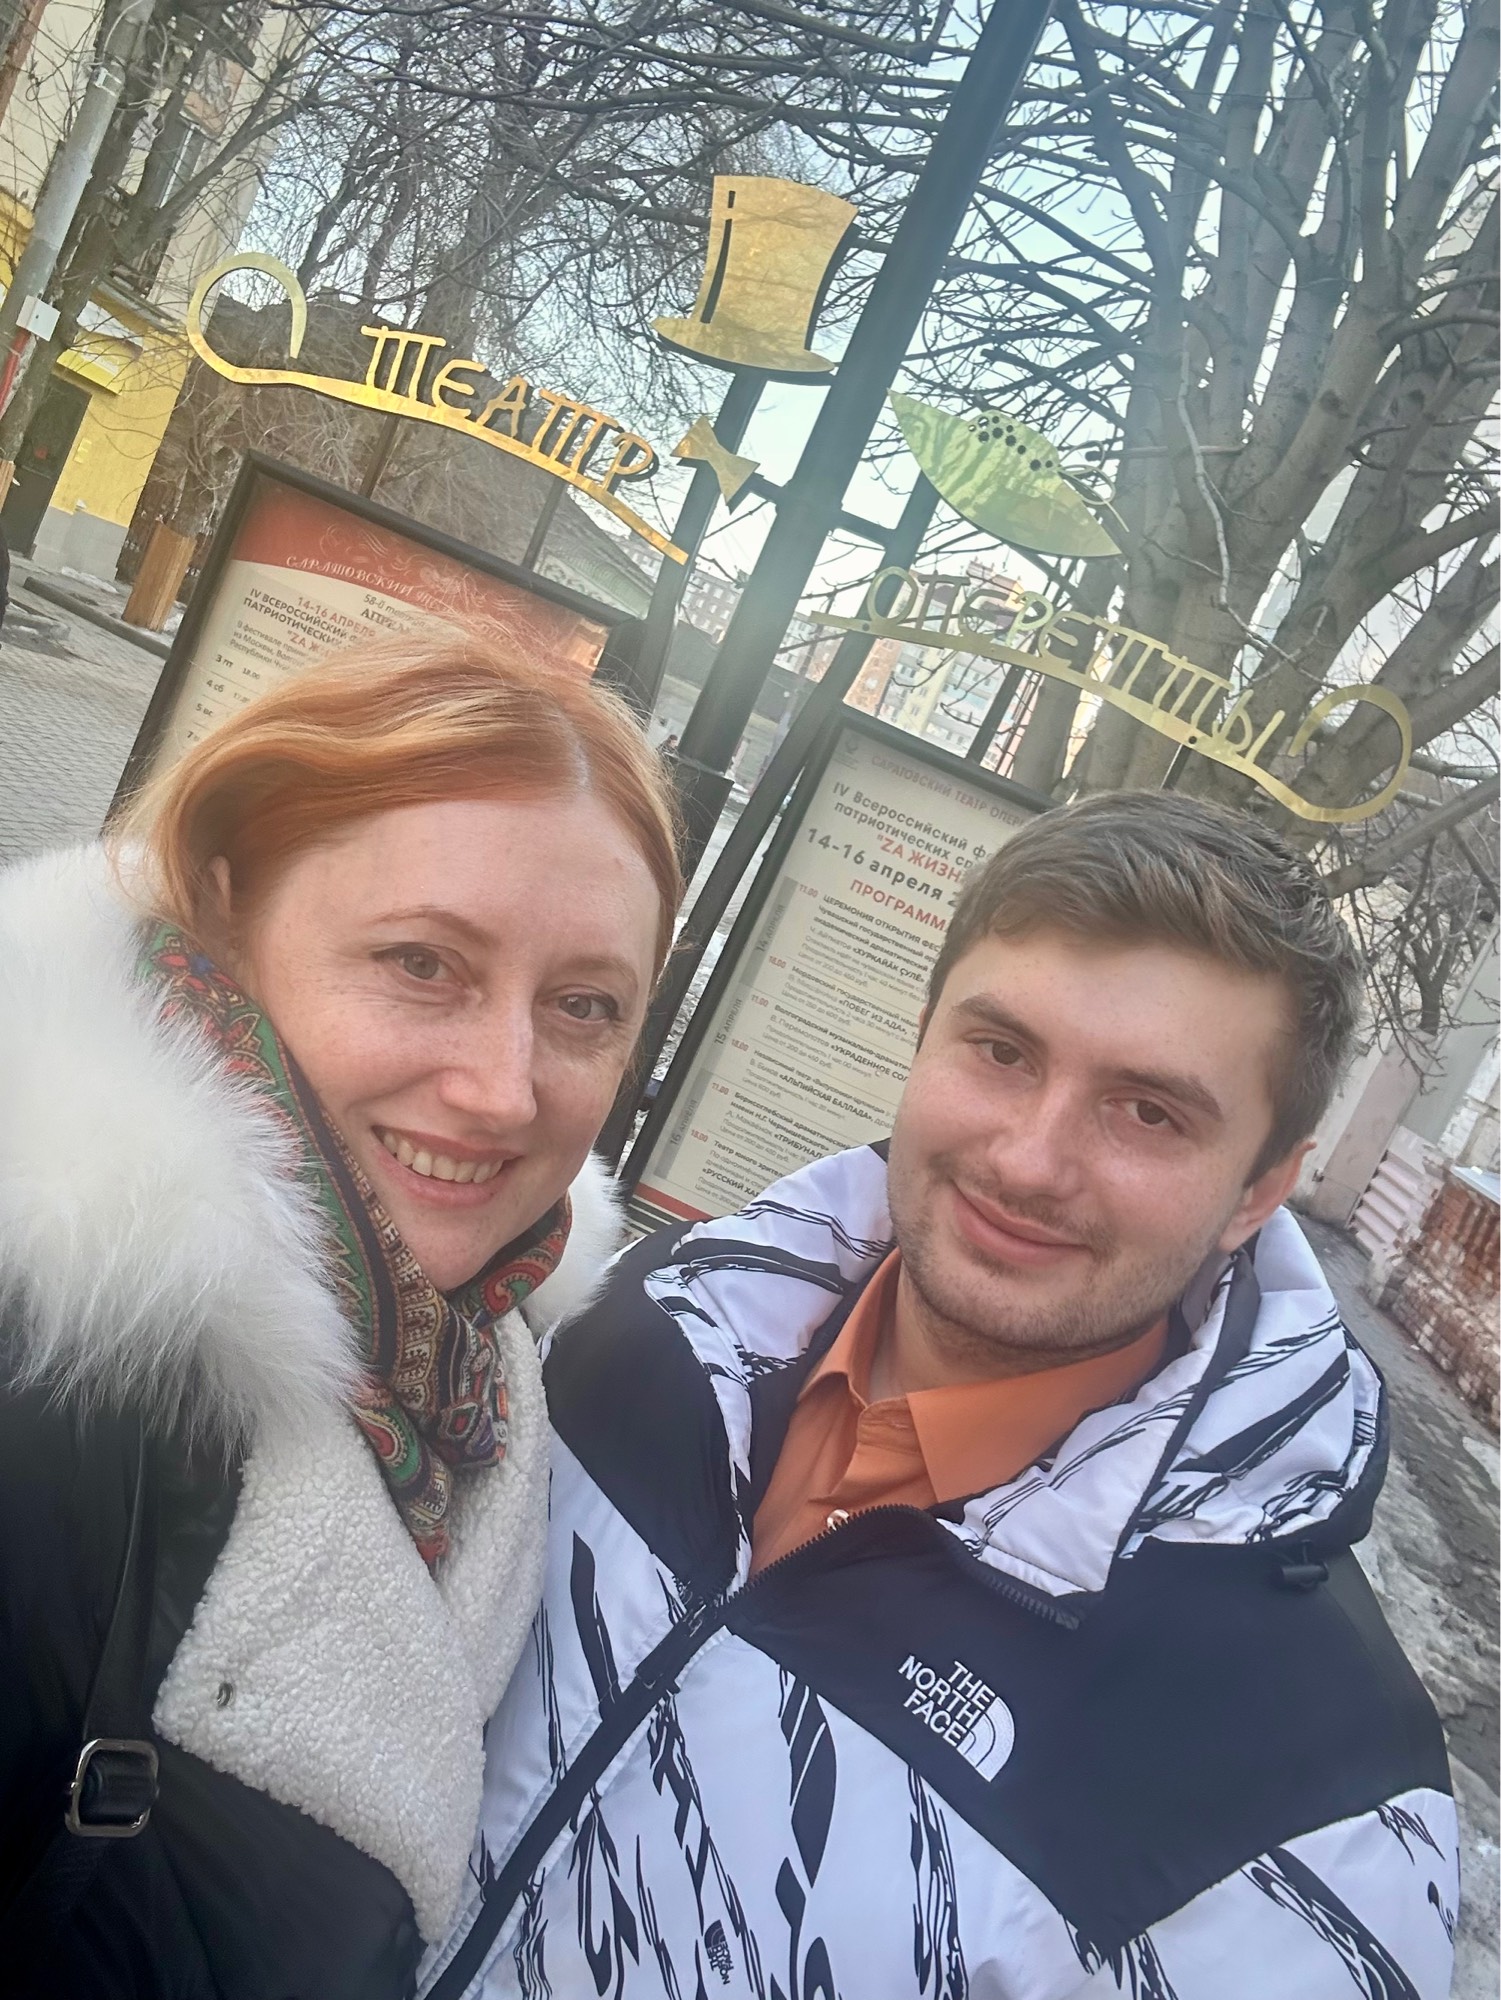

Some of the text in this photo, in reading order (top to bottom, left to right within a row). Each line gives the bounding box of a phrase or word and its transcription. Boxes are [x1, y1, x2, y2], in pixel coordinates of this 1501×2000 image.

[360, 325, 656, 486] ТЕАТР
[287, 556, 412, 596] САРАТОВСКИЙ
[251, 588, 348, 638] IV ВСЕРОССИЙСКИЙ
[298, 597, 328, 616] 14-16
[214, 682, 224, 692] сб
[223, 658, 233, 667] пт
[866, 566, 1286, 759] ОПЕРЕТТЫ
[203, 708, 213, 716] вс
[871, 755, 950, 796] САРАТОВСКИЙ
[955, 790, 987, 812] ТЕАТР
[833, 782, 968, 850] IV Всероссийский
[835, 801, 950, 859] патриотических
[805, 828, 866, 865] 14-16
[869, 860, 942, 900] апреля
[908, 850, 965, 884] ЖИЗН
[824, 895, 940, 952] ЦЕРЕМОНИЯ ОТКРЫТИЯ ФЕС
[850, 879, 951, 932] ПРОГРАММ
[839, 998, 869, 1015] «ПОБЕГ
[872, 1013, 882, 1022] ИЗ
[831, 1044, 890, 1074] «УКРАДЕННОЕ
[780, 1073, 831, 1101] «АЛЬПИЙСКАЯ
[714, 1141, 733, 1154] Театр
[703, 1167, 743, 1189] «РУССКИЙ
[898, 1655, 981, 1729] NORTH
[947, 1660, 995, 1710] THE
[903, 1688, 968, 1747] FACE
